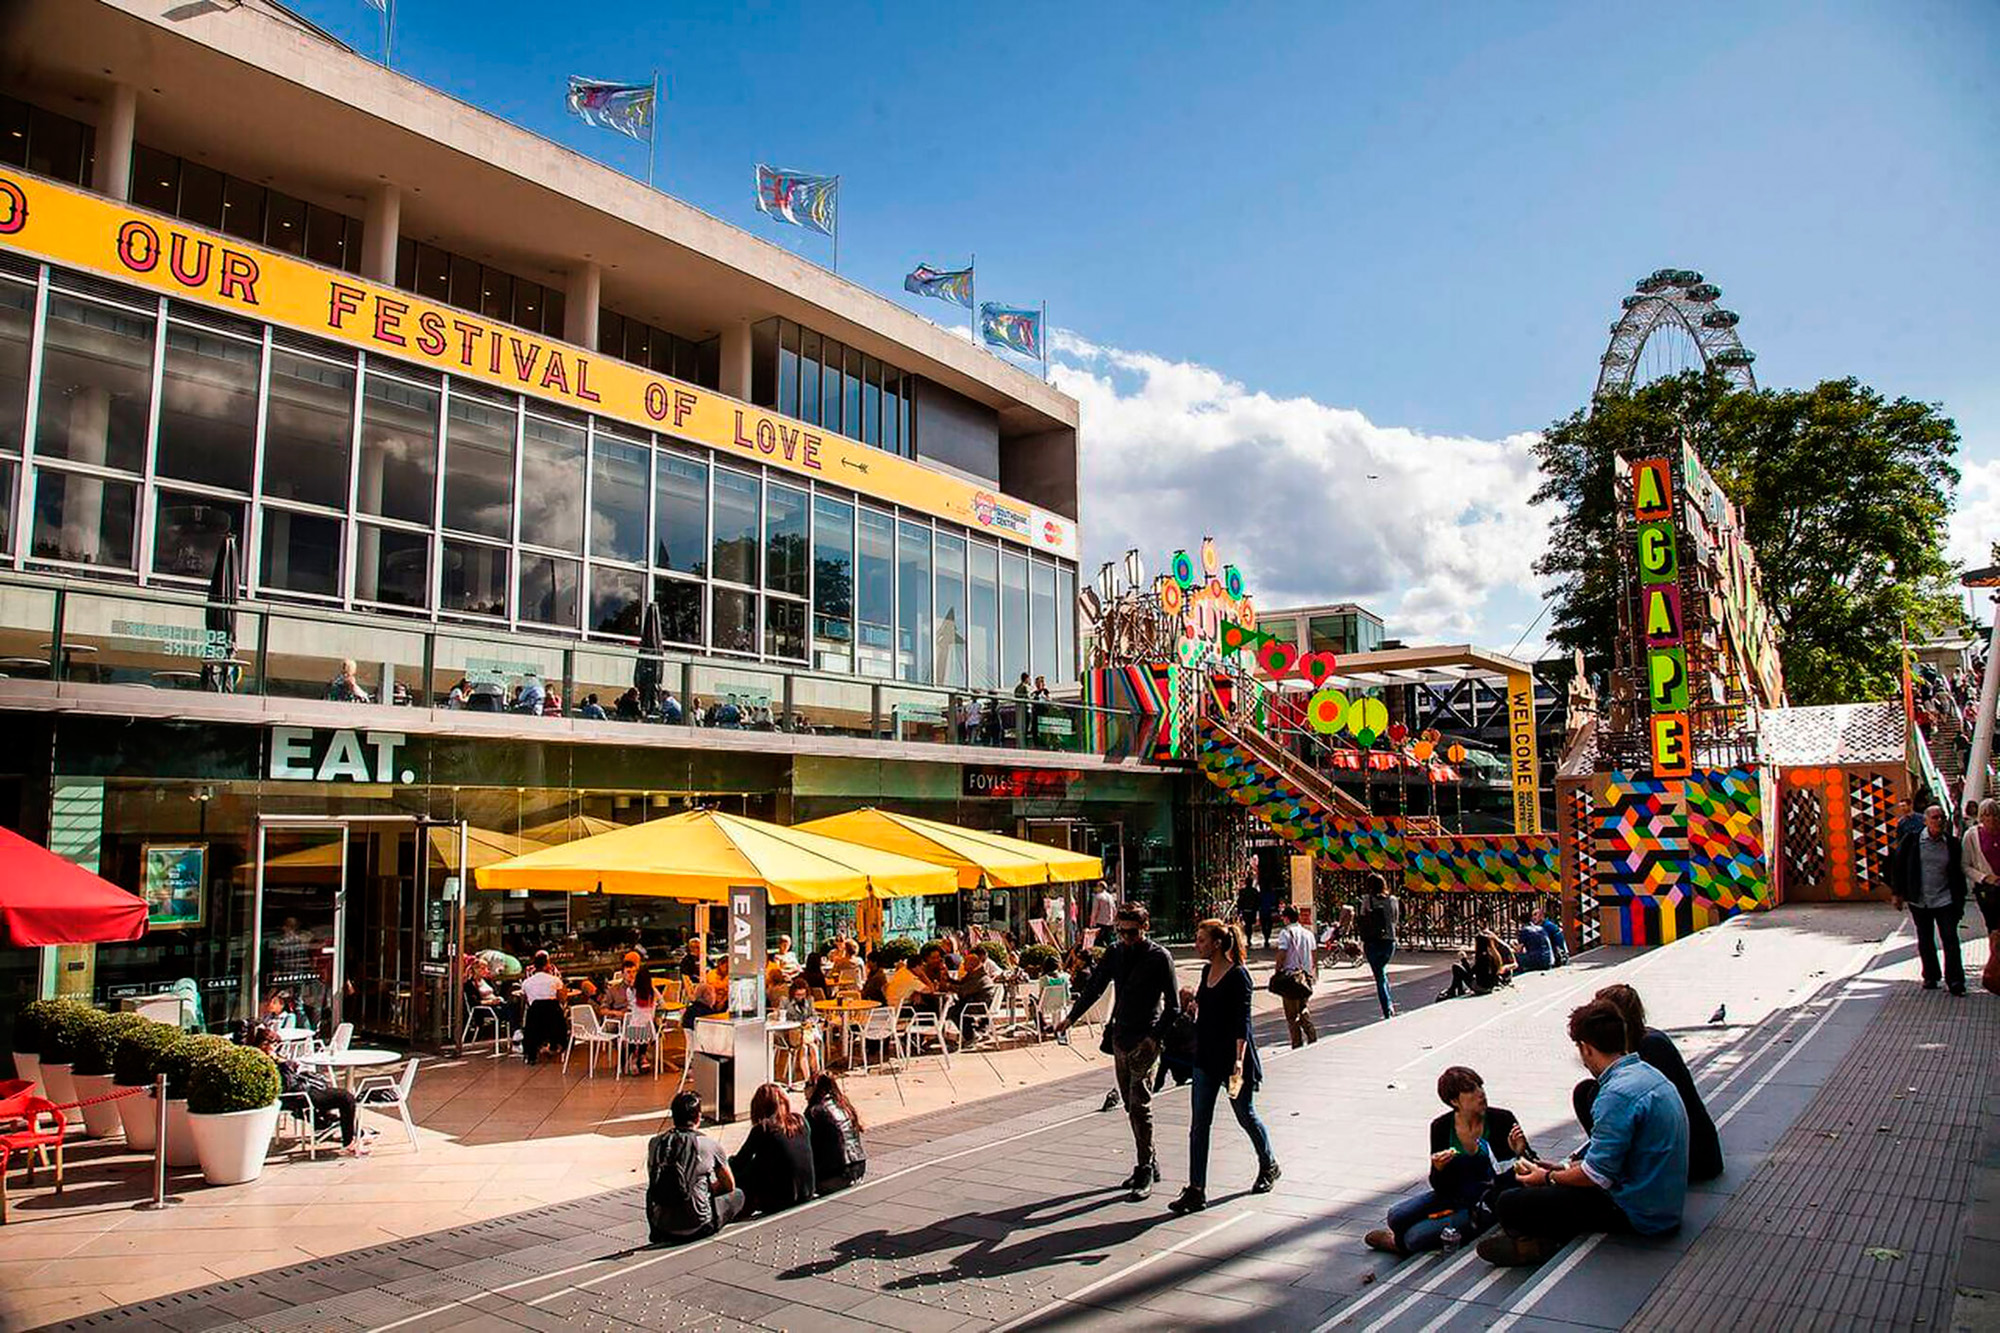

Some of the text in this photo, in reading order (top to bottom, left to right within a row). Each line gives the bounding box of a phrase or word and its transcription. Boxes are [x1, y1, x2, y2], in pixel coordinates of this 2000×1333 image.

[116, 221, 260, 305] OUR
[327, 282, 600, 402] FESTIVAL
[645, 382, 697, 427] OF
[734, 411, 822, 470] LOVE
[1637, 466, 1685, 770] AGAPE
[269, 726, 416, 785] EAT.
[1513, 691, 1533, 786] WELCOME
[969, 773, 1014, 791] FOYLES
[1525, 790, 1536, 835] SOUTHBAN
[733, 894, 751, 964] EAT.
